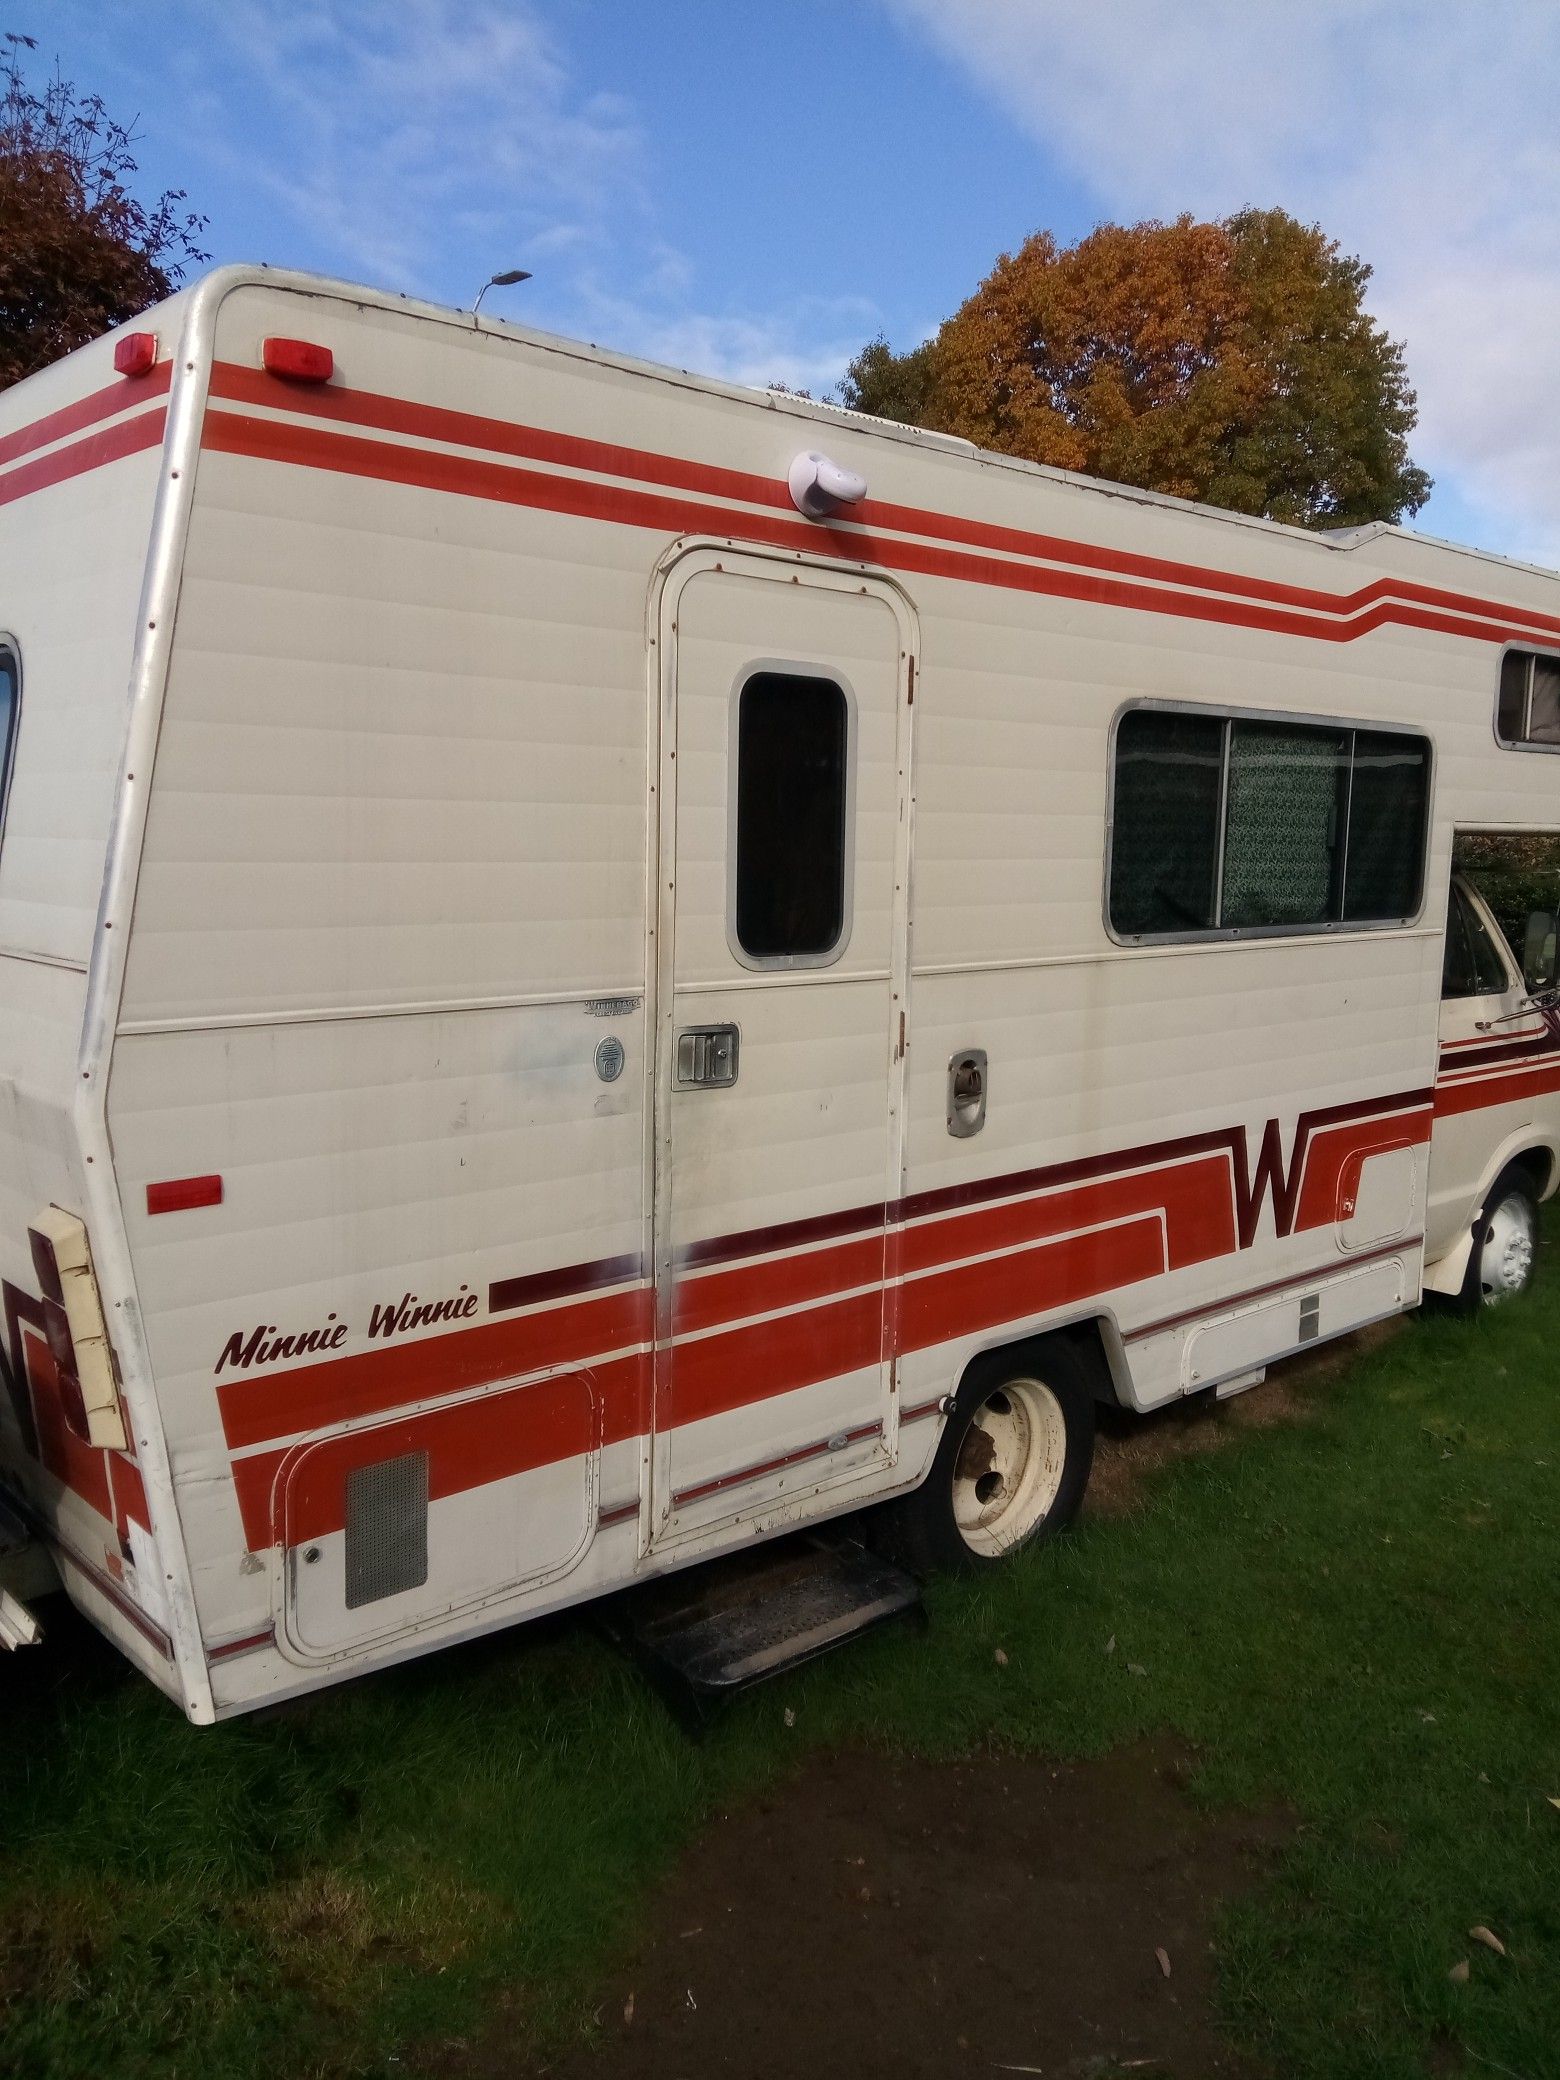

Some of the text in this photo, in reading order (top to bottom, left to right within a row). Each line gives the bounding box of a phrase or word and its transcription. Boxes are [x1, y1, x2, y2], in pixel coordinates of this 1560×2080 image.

[1231, 1112, 1309, 1250] W
[214, 1284, 478, 1374] Minnie Winnie
